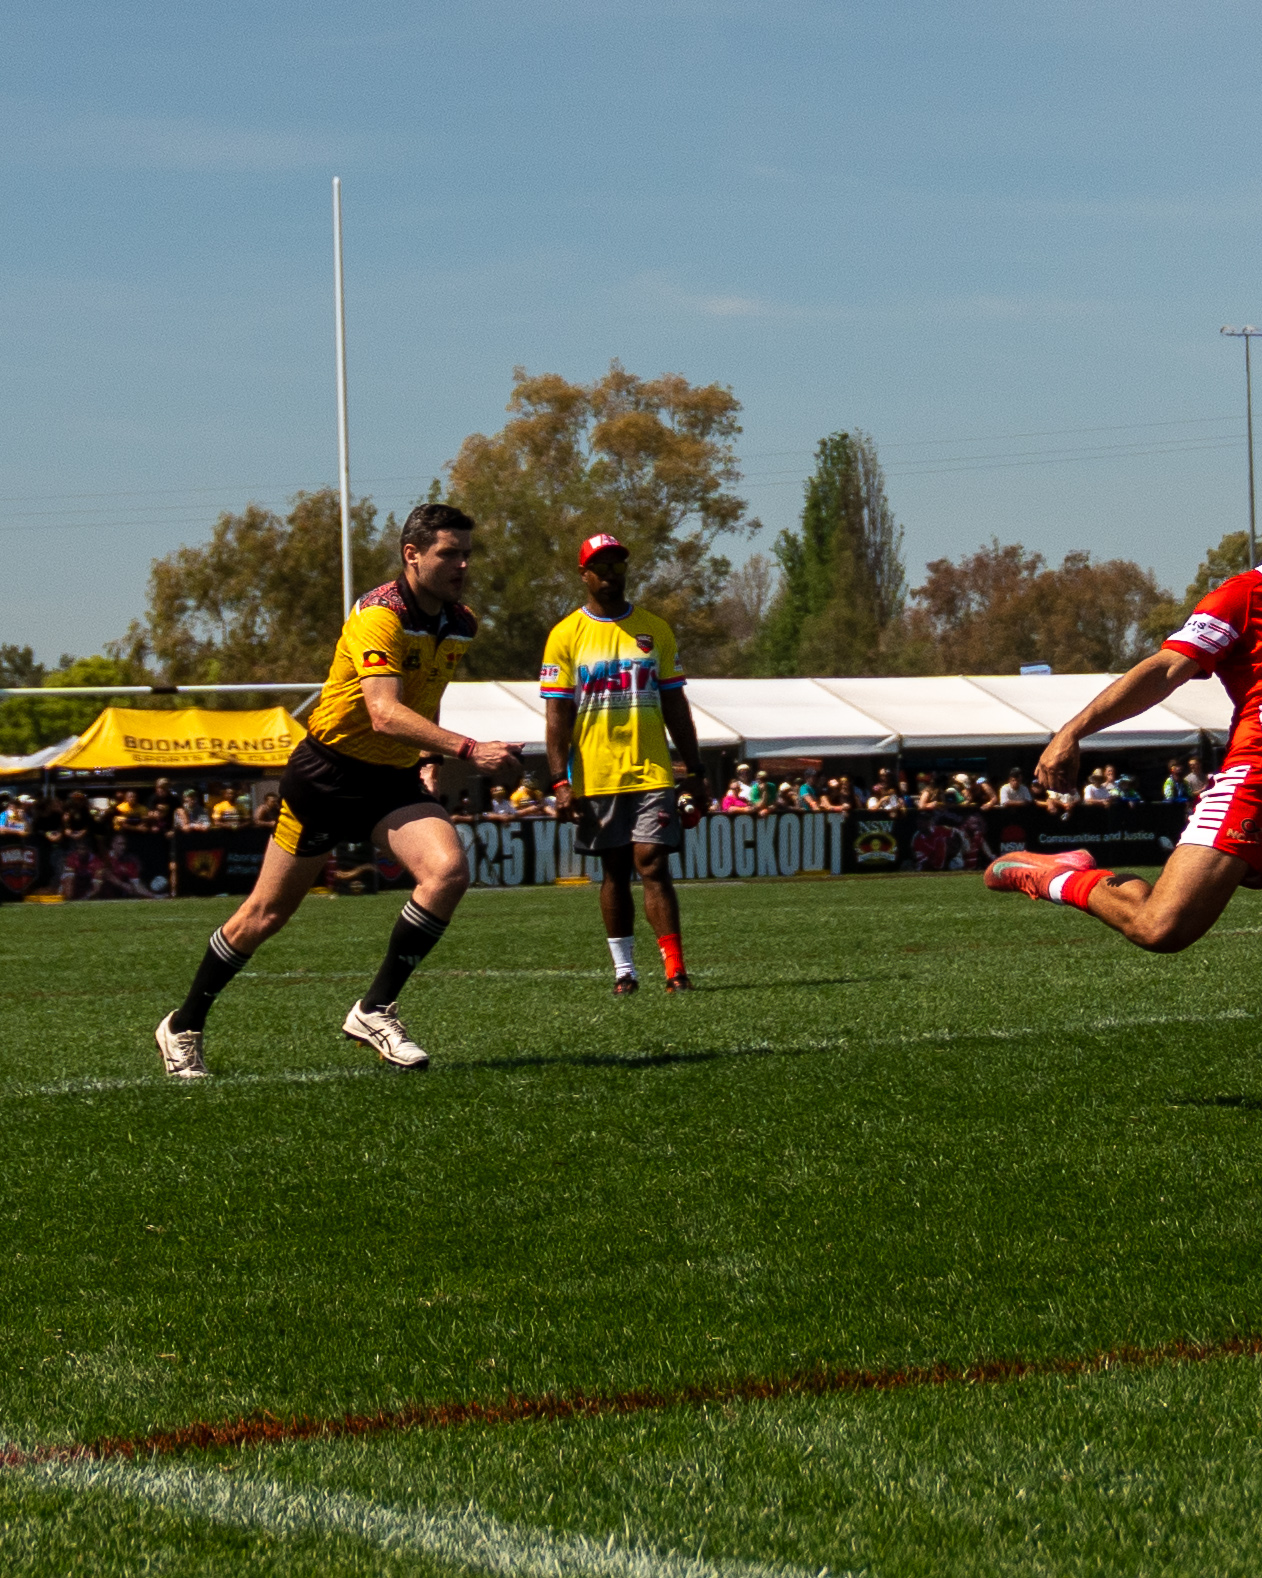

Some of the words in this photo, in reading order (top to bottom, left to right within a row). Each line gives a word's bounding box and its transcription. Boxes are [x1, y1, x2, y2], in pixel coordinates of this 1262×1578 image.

[124, 734, 293, 752] BOOMERANGS
[858, 821, 895, 834] NSW
[1038, 833, 1101, 844] Communities
[1103, 832, 1122, 842] and
[1124, 830, 1155, 841] Justice
[454, 820, 525, 885] 025
[1000, 842, 1025, 853] NSW
